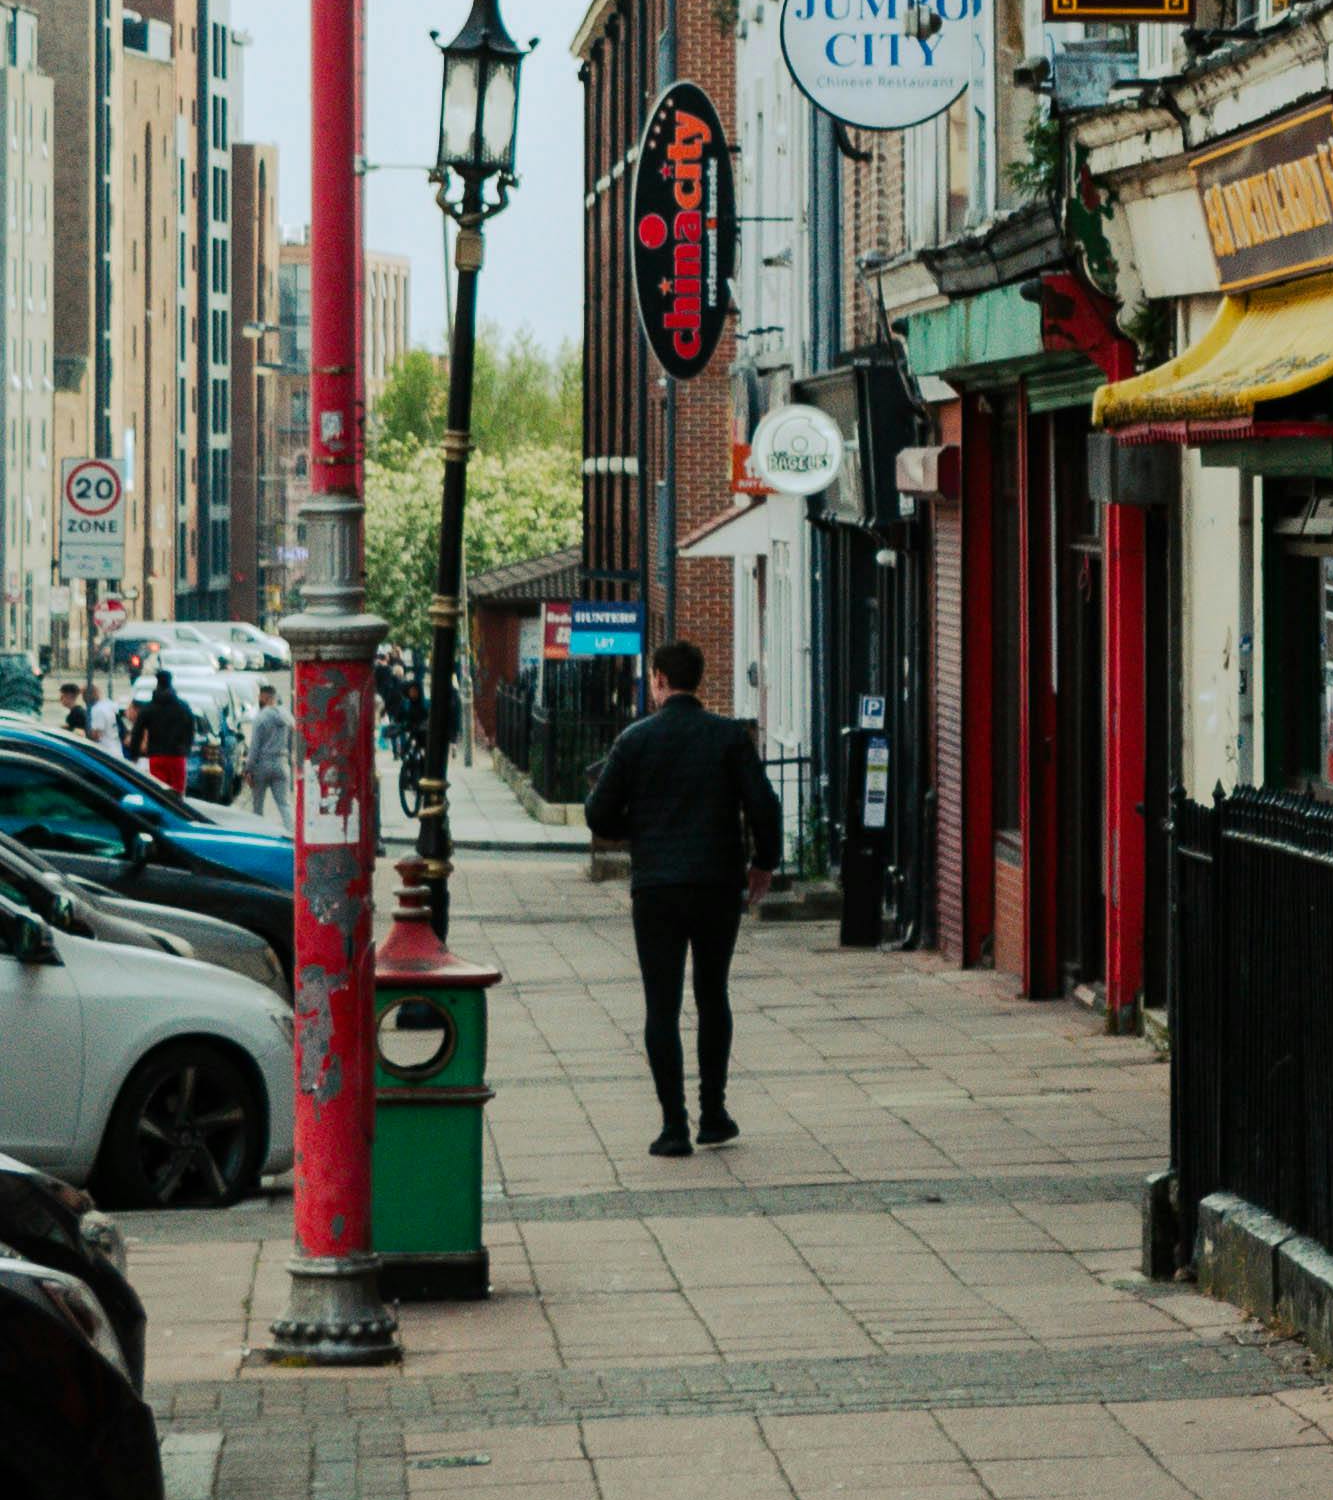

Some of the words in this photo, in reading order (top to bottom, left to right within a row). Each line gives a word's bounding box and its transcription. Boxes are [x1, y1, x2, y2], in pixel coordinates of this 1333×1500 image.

[824, 32, 944, 68] CITY
[816, 75, 874, 89] Chinese
[877, 75, 954, 89] Restaurant
[75, 477, 114, 500] 20
[67, 518, 118, 534] ZONE
